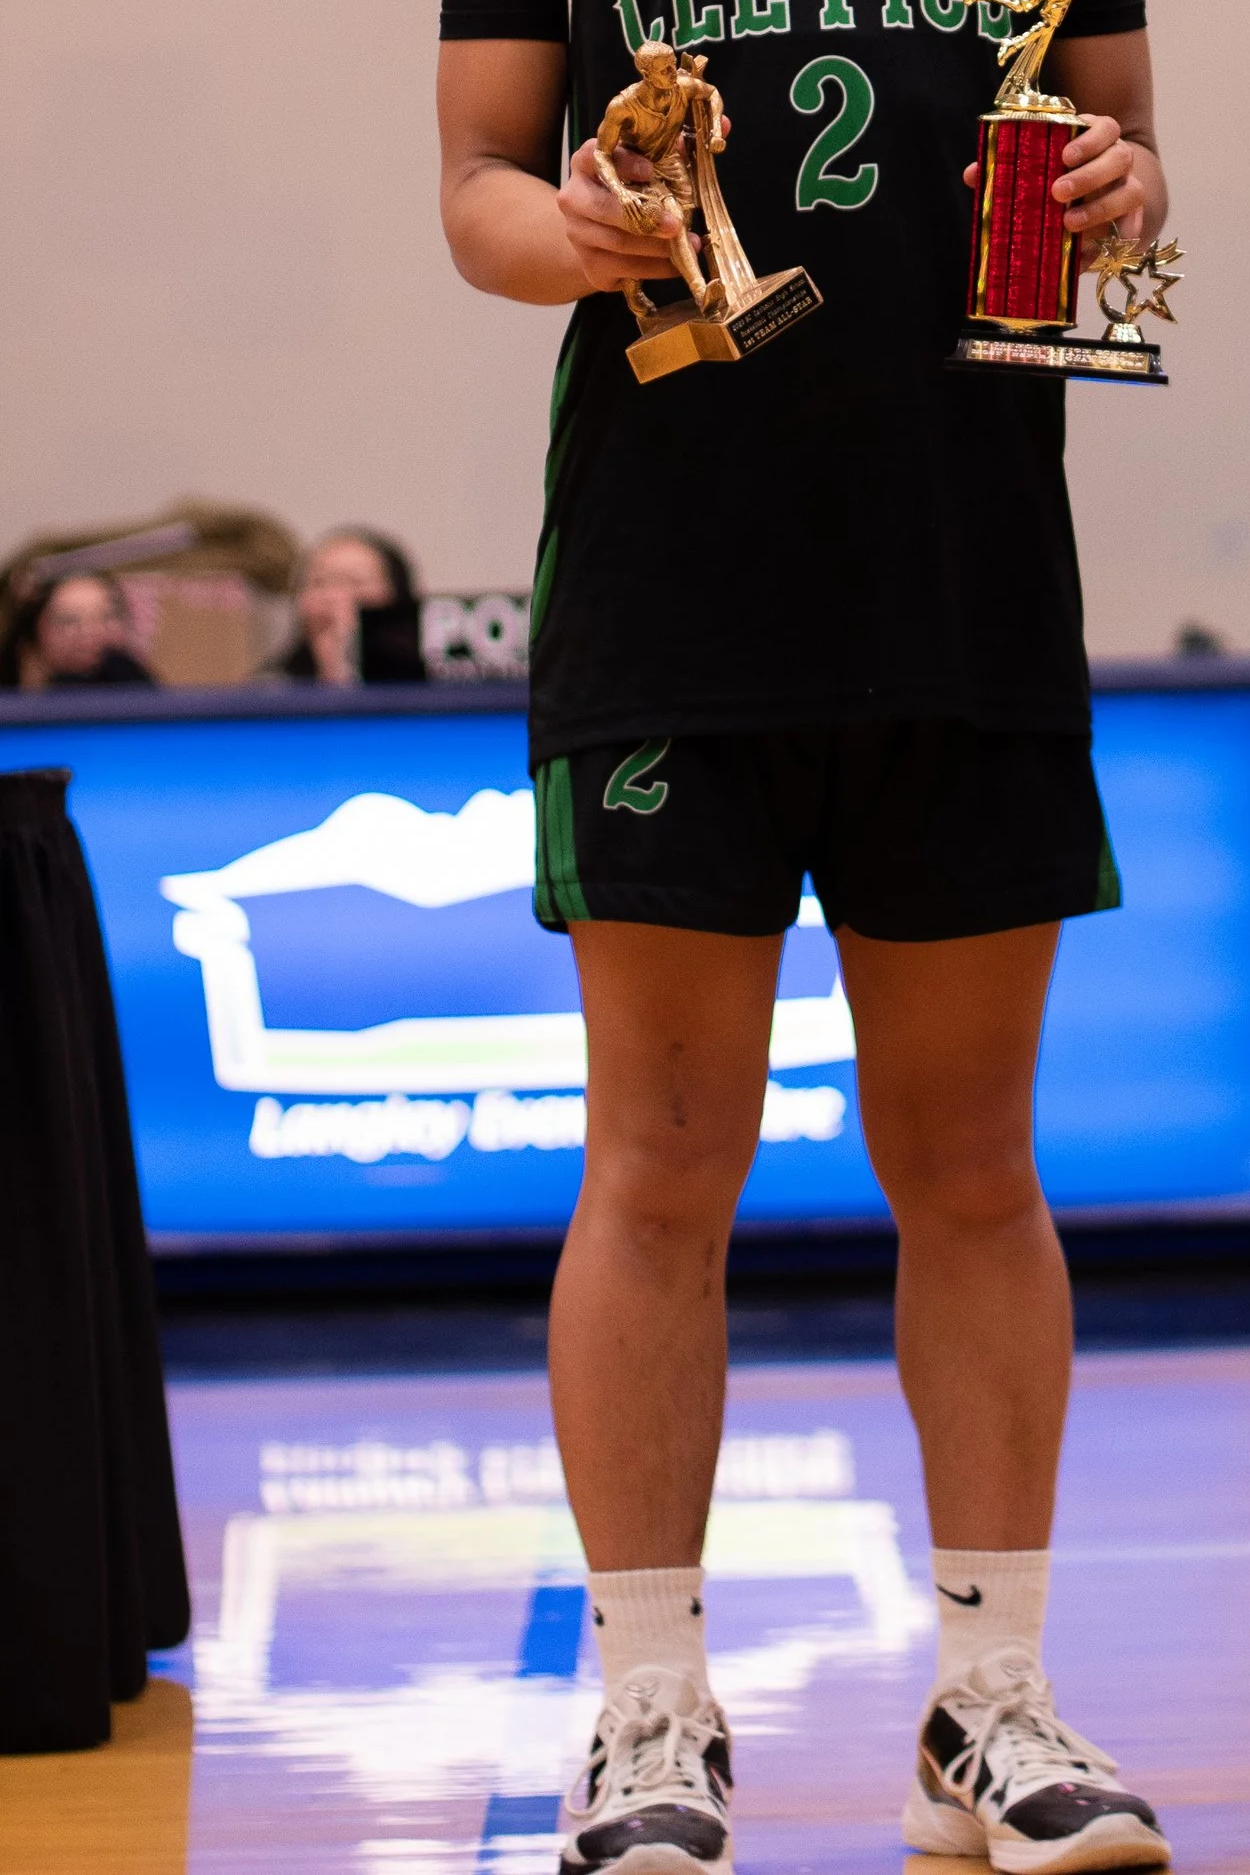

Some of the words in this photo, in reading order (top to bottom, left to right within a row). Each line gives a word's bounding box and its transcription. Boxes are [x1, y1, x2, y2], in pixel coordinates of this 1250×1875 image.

[789, 54, 879, 211] 2
[754, 320, 777, 340] TEAM
[776, 295, 813, 325] ALL-STAR
